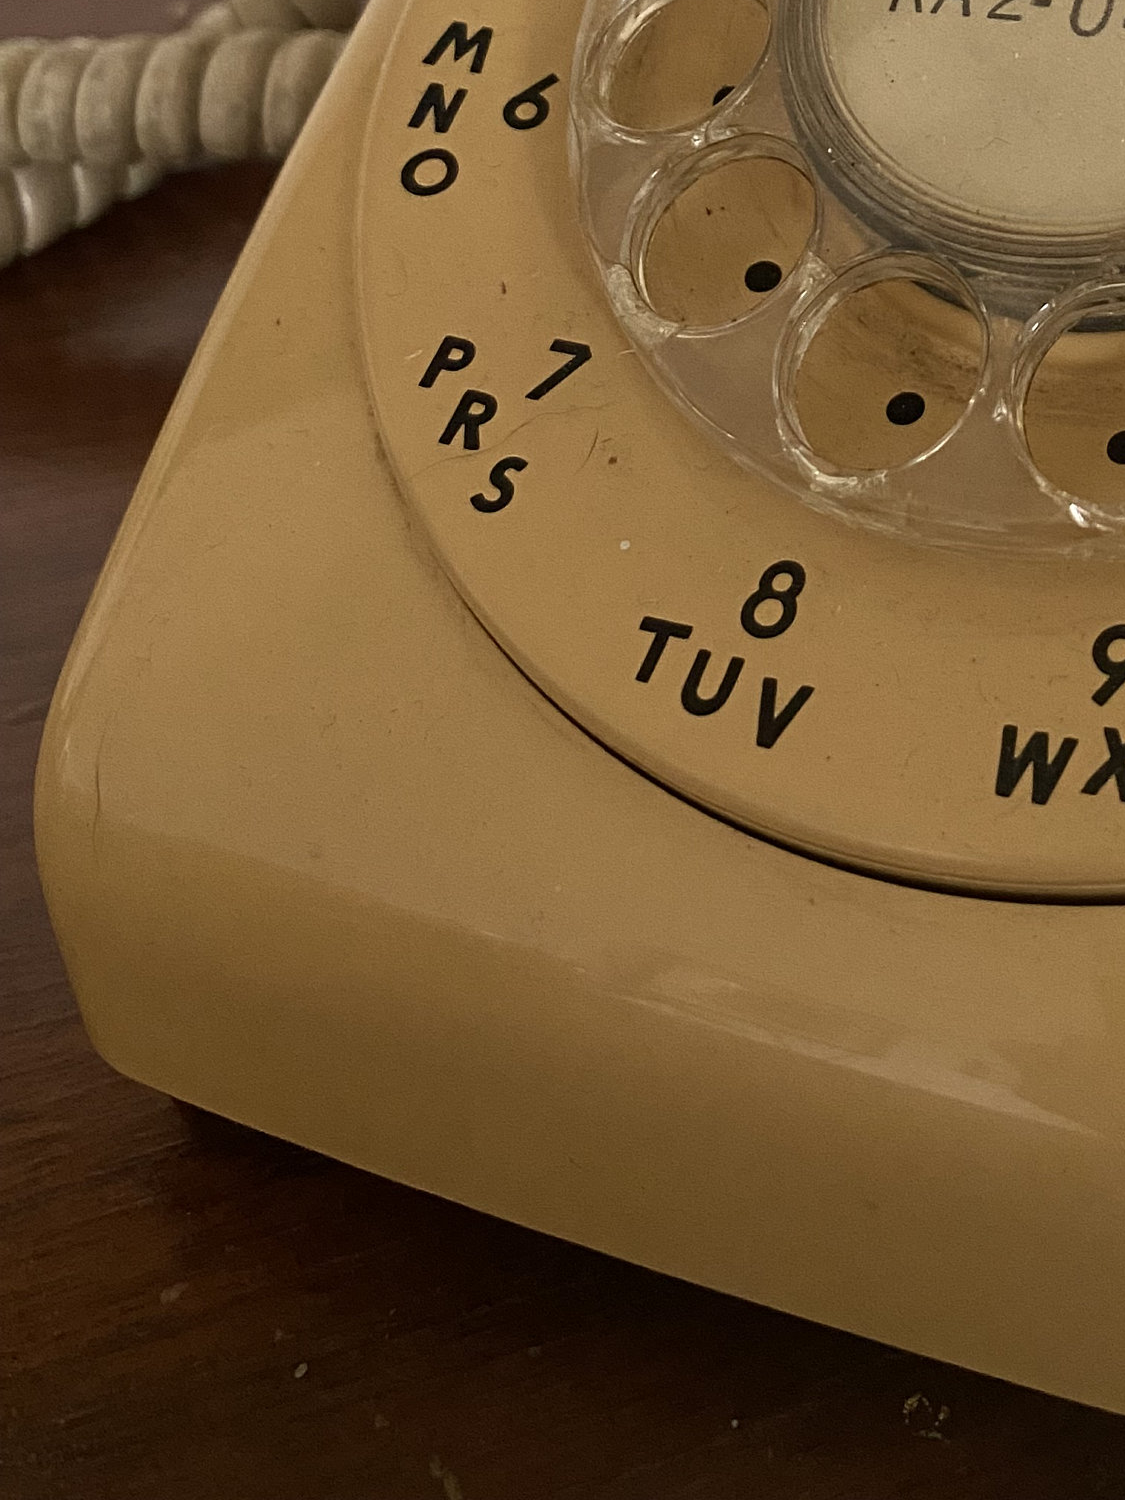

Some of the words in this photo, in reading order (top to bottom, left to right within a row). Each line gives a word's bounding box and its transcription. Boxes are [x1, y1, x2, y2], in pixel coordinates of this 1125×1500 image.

[502, 73, 561, 131] 6
[524, 338, 593, 401] 7
[418, 335, 529, 514] PRS
[740, 560, 807, 640] 8
[634, 616, 816, 750] TUV
